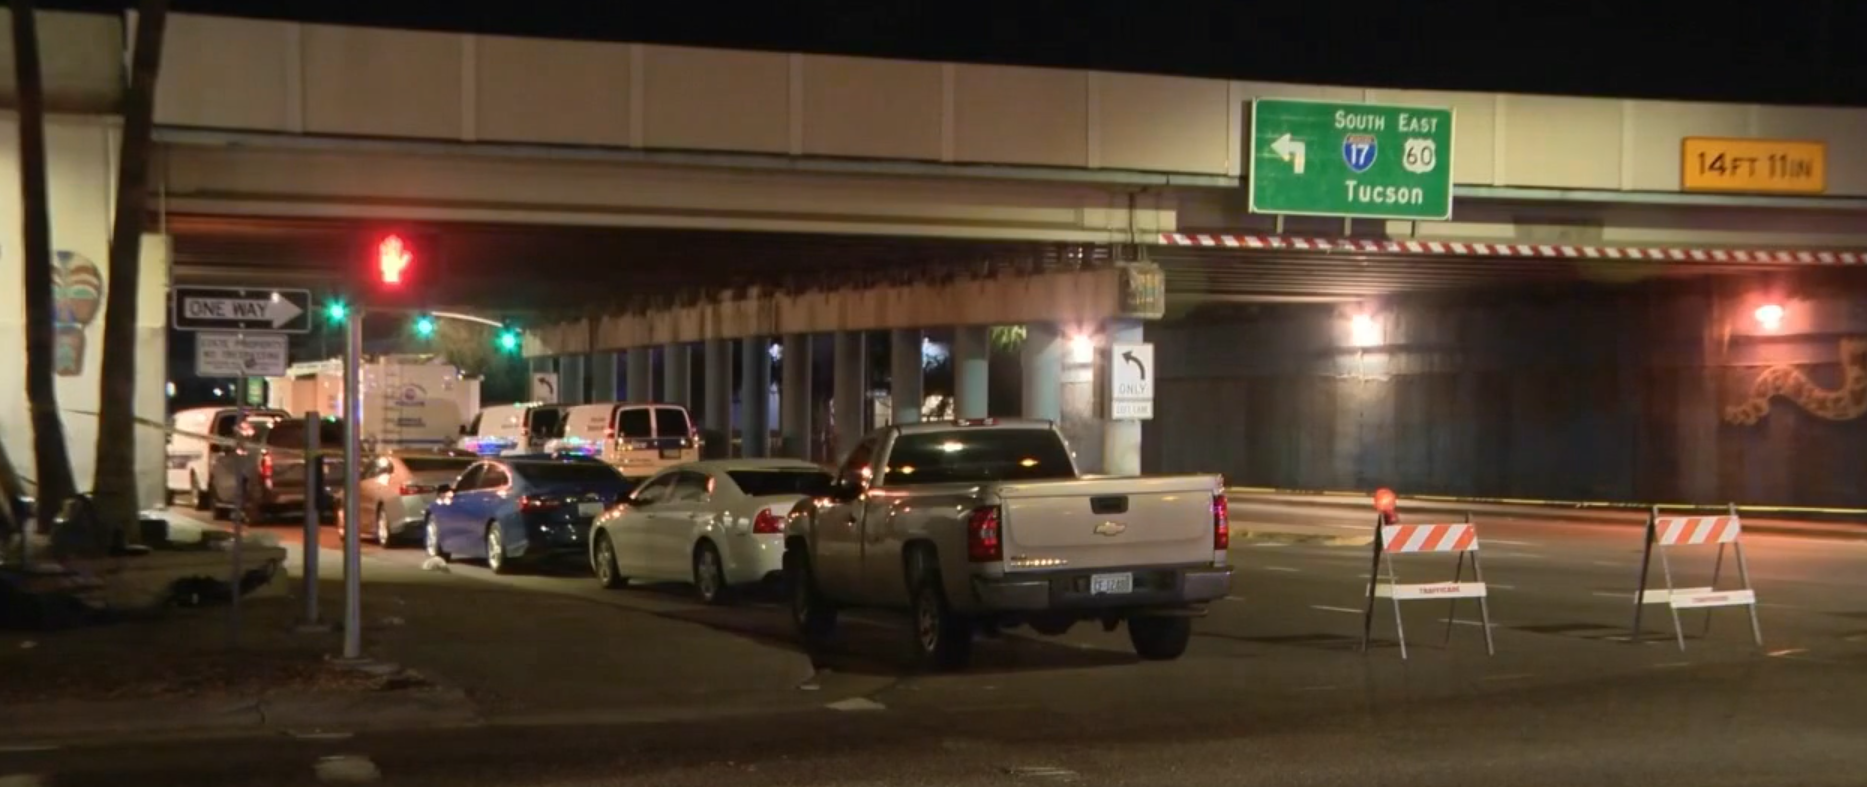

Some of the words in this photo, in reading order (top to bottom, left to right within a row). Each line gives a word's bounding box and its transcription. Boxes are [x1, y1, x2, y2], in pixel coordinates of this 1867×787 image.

[1335, 110, 1385, 131] SOUTH
[1398, 113, 1438, 133] EAST
[1351, 144, 1370, 165] 17
[1406, 146, 1433, 166] 60
[1345, 180, 1424, 205] Tucson
[190, 301, 225, 316] ONE
[231, 302, 268, 317] WAY
[1119, 383, 1146, 395] ONLY
